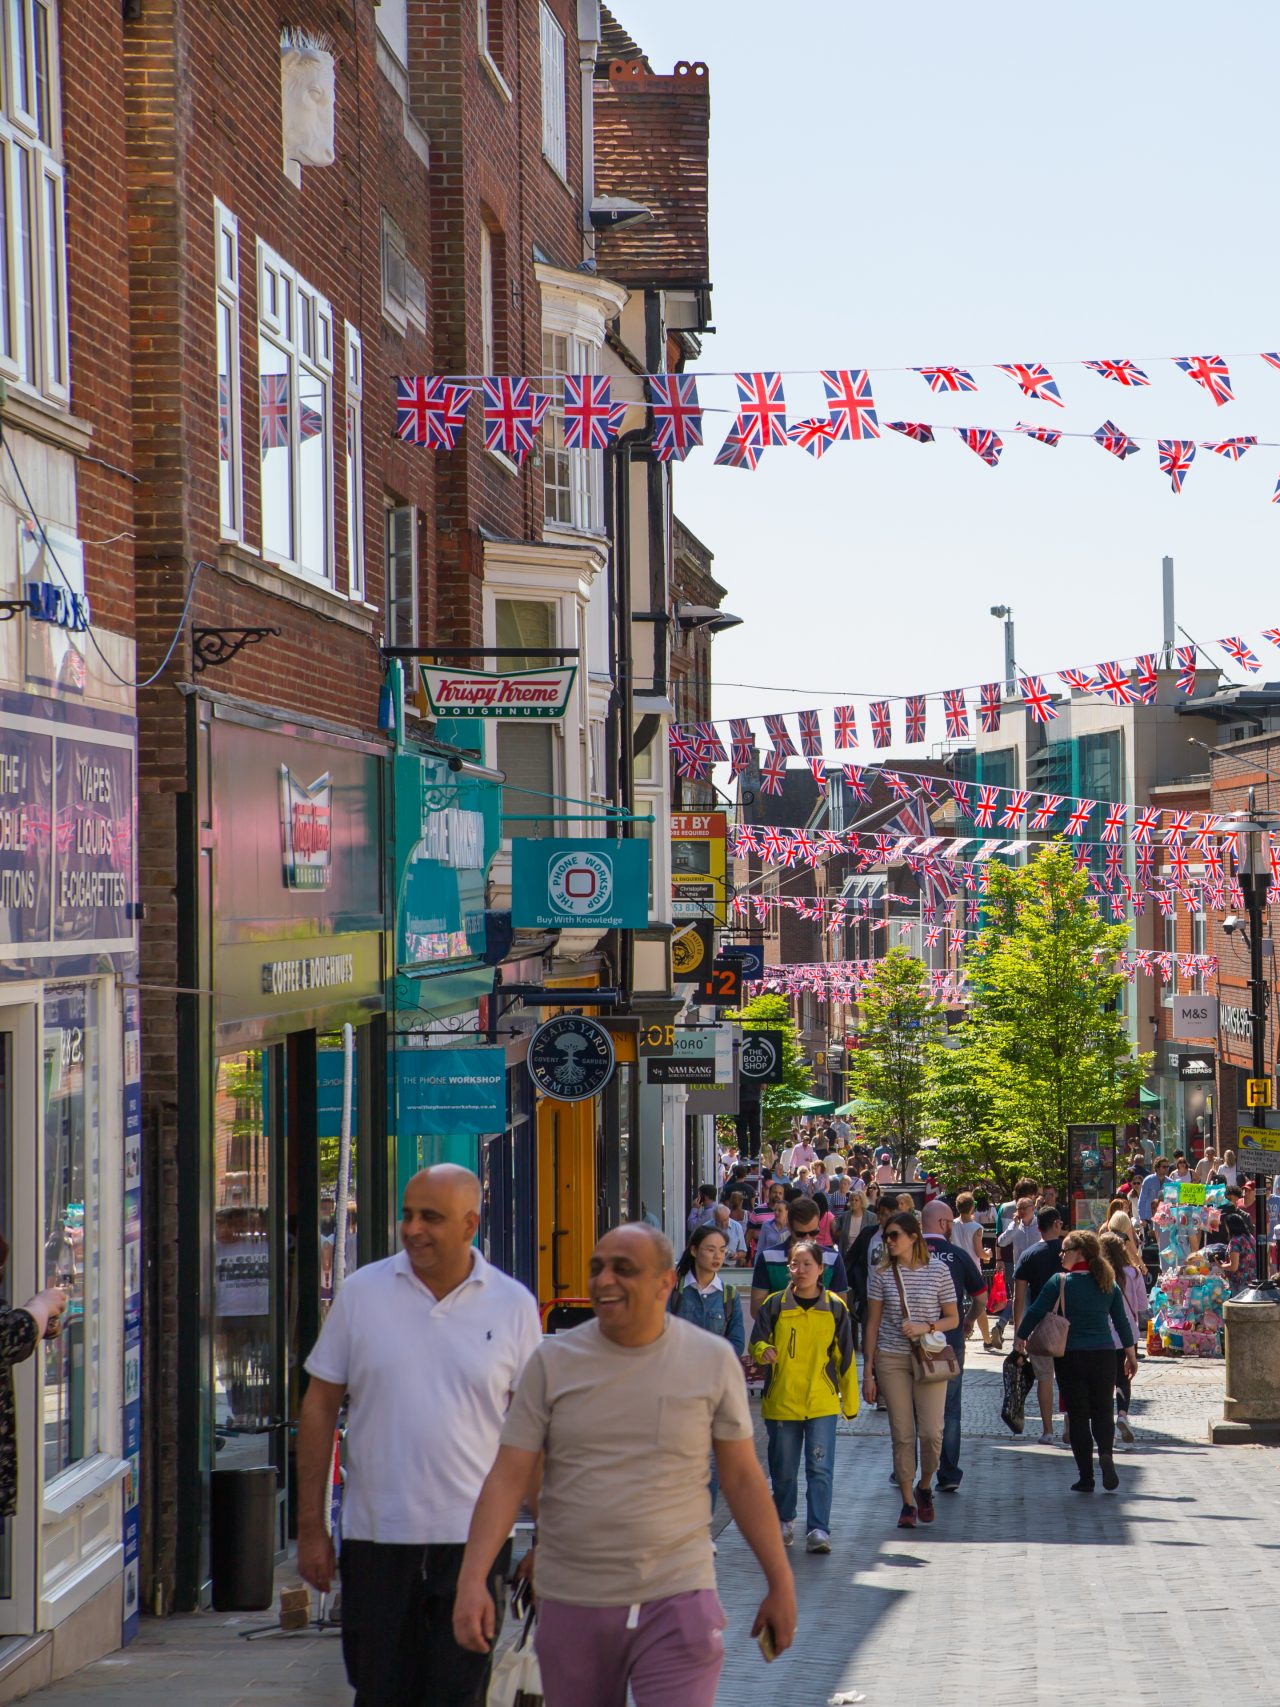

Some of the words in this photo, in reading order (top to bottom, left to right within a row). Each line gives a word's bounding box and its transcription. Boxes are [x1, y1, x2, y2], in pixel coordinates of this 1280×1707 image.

[436, 679, 498, 706] Krispy
[498, 679, 562, 703] Kreme
[439, 708, 555, 716] DOUGHNUTS
[80, 766, 111, 803] VAPES
[0, 811, 28, 851] OBILE
[671, 816, 688, 829] ET
[692, 816, 712, 830] BY
[77, 818, 113, 855] LIQUIDS
[0, 869, 35, 908] TIONS
[61, 871, 126, 908] E-CIGARETTES
[553, 856, 578, 886] PHONE
[585, 857, 608, 908] WORKSHOP
[556, 891, 574, 909] THE
[537, 916, 552, 925] Buy
[554, 916, 575, 924] With
[576, 916, 624, 926] Knowledge
[272, 960, 300, 996] COFFEE
[310, 953, 353, 989] DOUGHNUTS
[1182, 1008, 1208, 1019] M&S
[534, 1020, 576, 1053] NEAL'S
[580, 1022, 608, 1055] YARD
[743, 1055, 769, 1064] BODY
[744, 1062, 768, 1070] SHOP
[668, 1066, 689, 1074] NAM
[689, 1066, 712, 1074] KANG
[1182, 1067, 1213, 1075] TRESPASS
[403, 1076, 417, 1085] THE
[419, 1076, 448, 1085] PHONE
[449, 1075, 501, 1084] WORKSHOP
[536, 1066, 604, 1095] REMEDIES
[1240, 1128, 1268, 1136] Pedestrian
[1269, 1129, 1280, 1137] Zone
